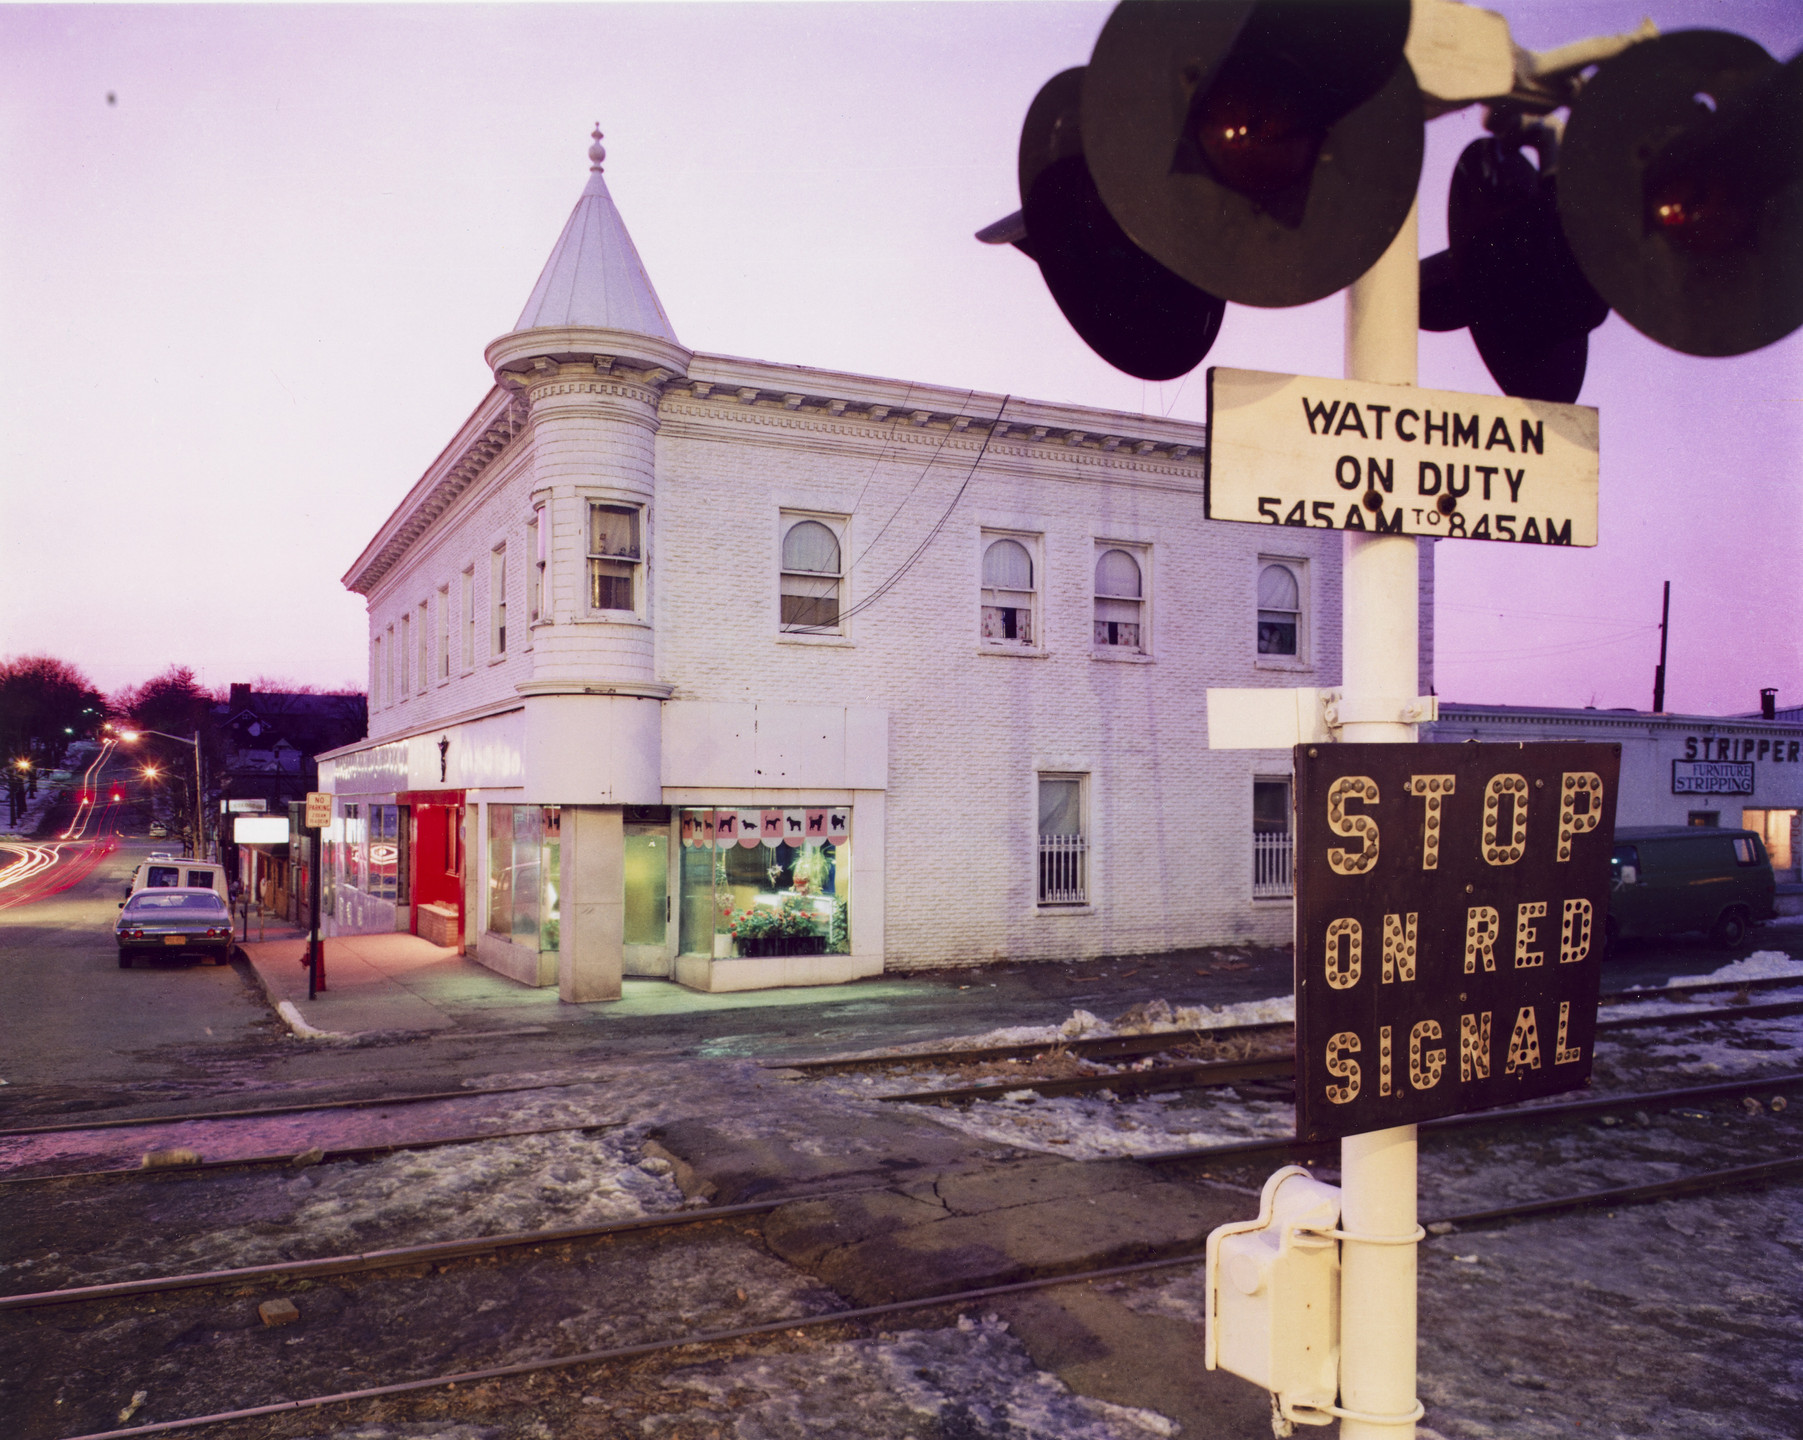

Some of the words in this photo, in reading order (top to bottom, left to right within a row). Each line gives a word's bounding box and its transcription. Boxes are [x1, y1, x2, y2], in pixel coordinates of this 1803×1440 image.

[1302, 397, 1544, 455] WATCHMAN
[1335, 455, 1394, 493] ON
[1418, 461, 1525, 503] DUTY
[1411, 508, 1441, 526] TO
[1448, 511, 1573, 546] 845AM
[1685, 736, 1800, 763] STRIPPER
[1676, 777, 1752, 791] STRIPPING
[1692, 763, 1752, 777] FURNITURE
[309, 804, 331, 812] PARKING
[315, 796, 325, 804] NO
[1327, 772, 1603, 875] STOP
[1325, 912, 1419, 990] ON
[1464, 898, 1593, 975] RED
[1325, 1001, 1581, 1104] SIGNAL
